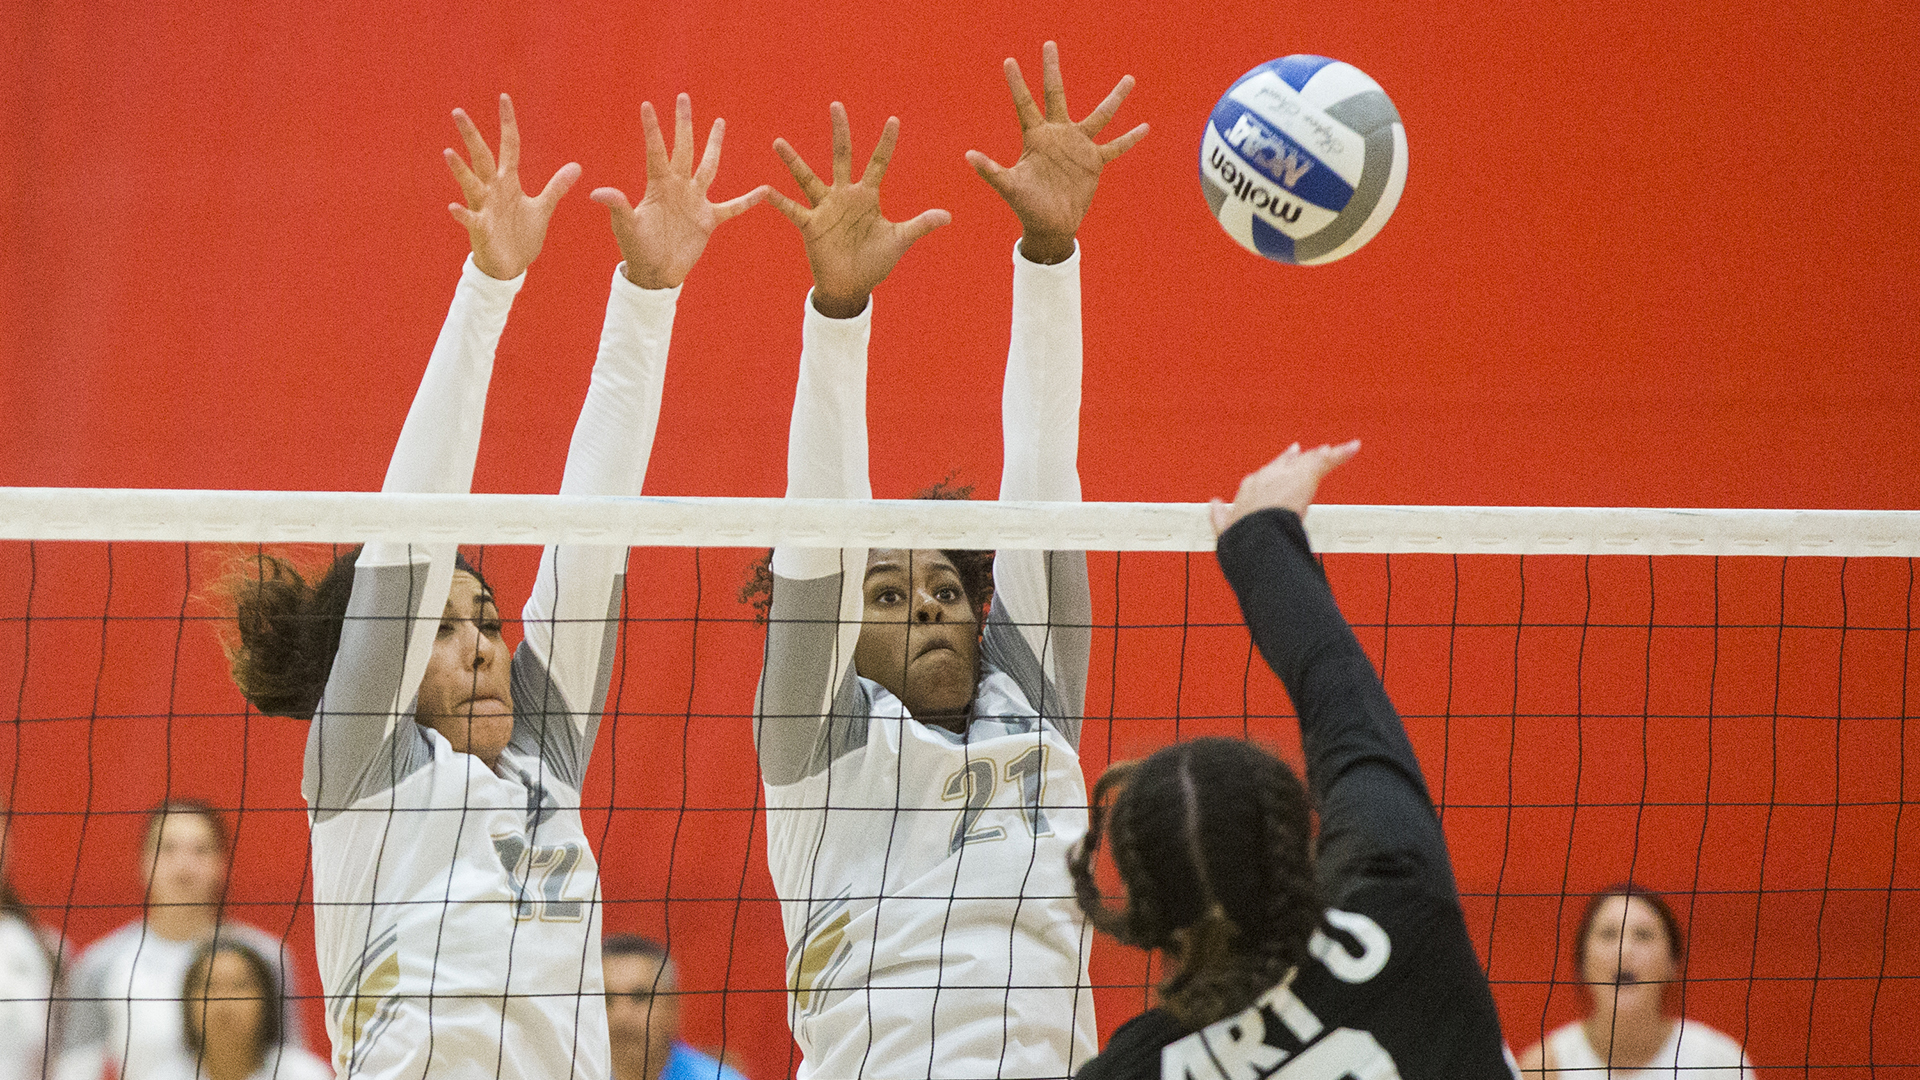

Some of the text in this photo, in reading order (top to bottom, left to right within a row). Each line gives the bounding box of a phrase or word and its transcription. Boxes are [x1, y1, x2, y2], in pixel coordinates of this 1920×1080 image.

[1209, 146, 1303, 223] molten
[1227, 112, 1314, 187] NCAA
[941, 744, 1055, 858] 21
[490, 830, 584, 924] 12
